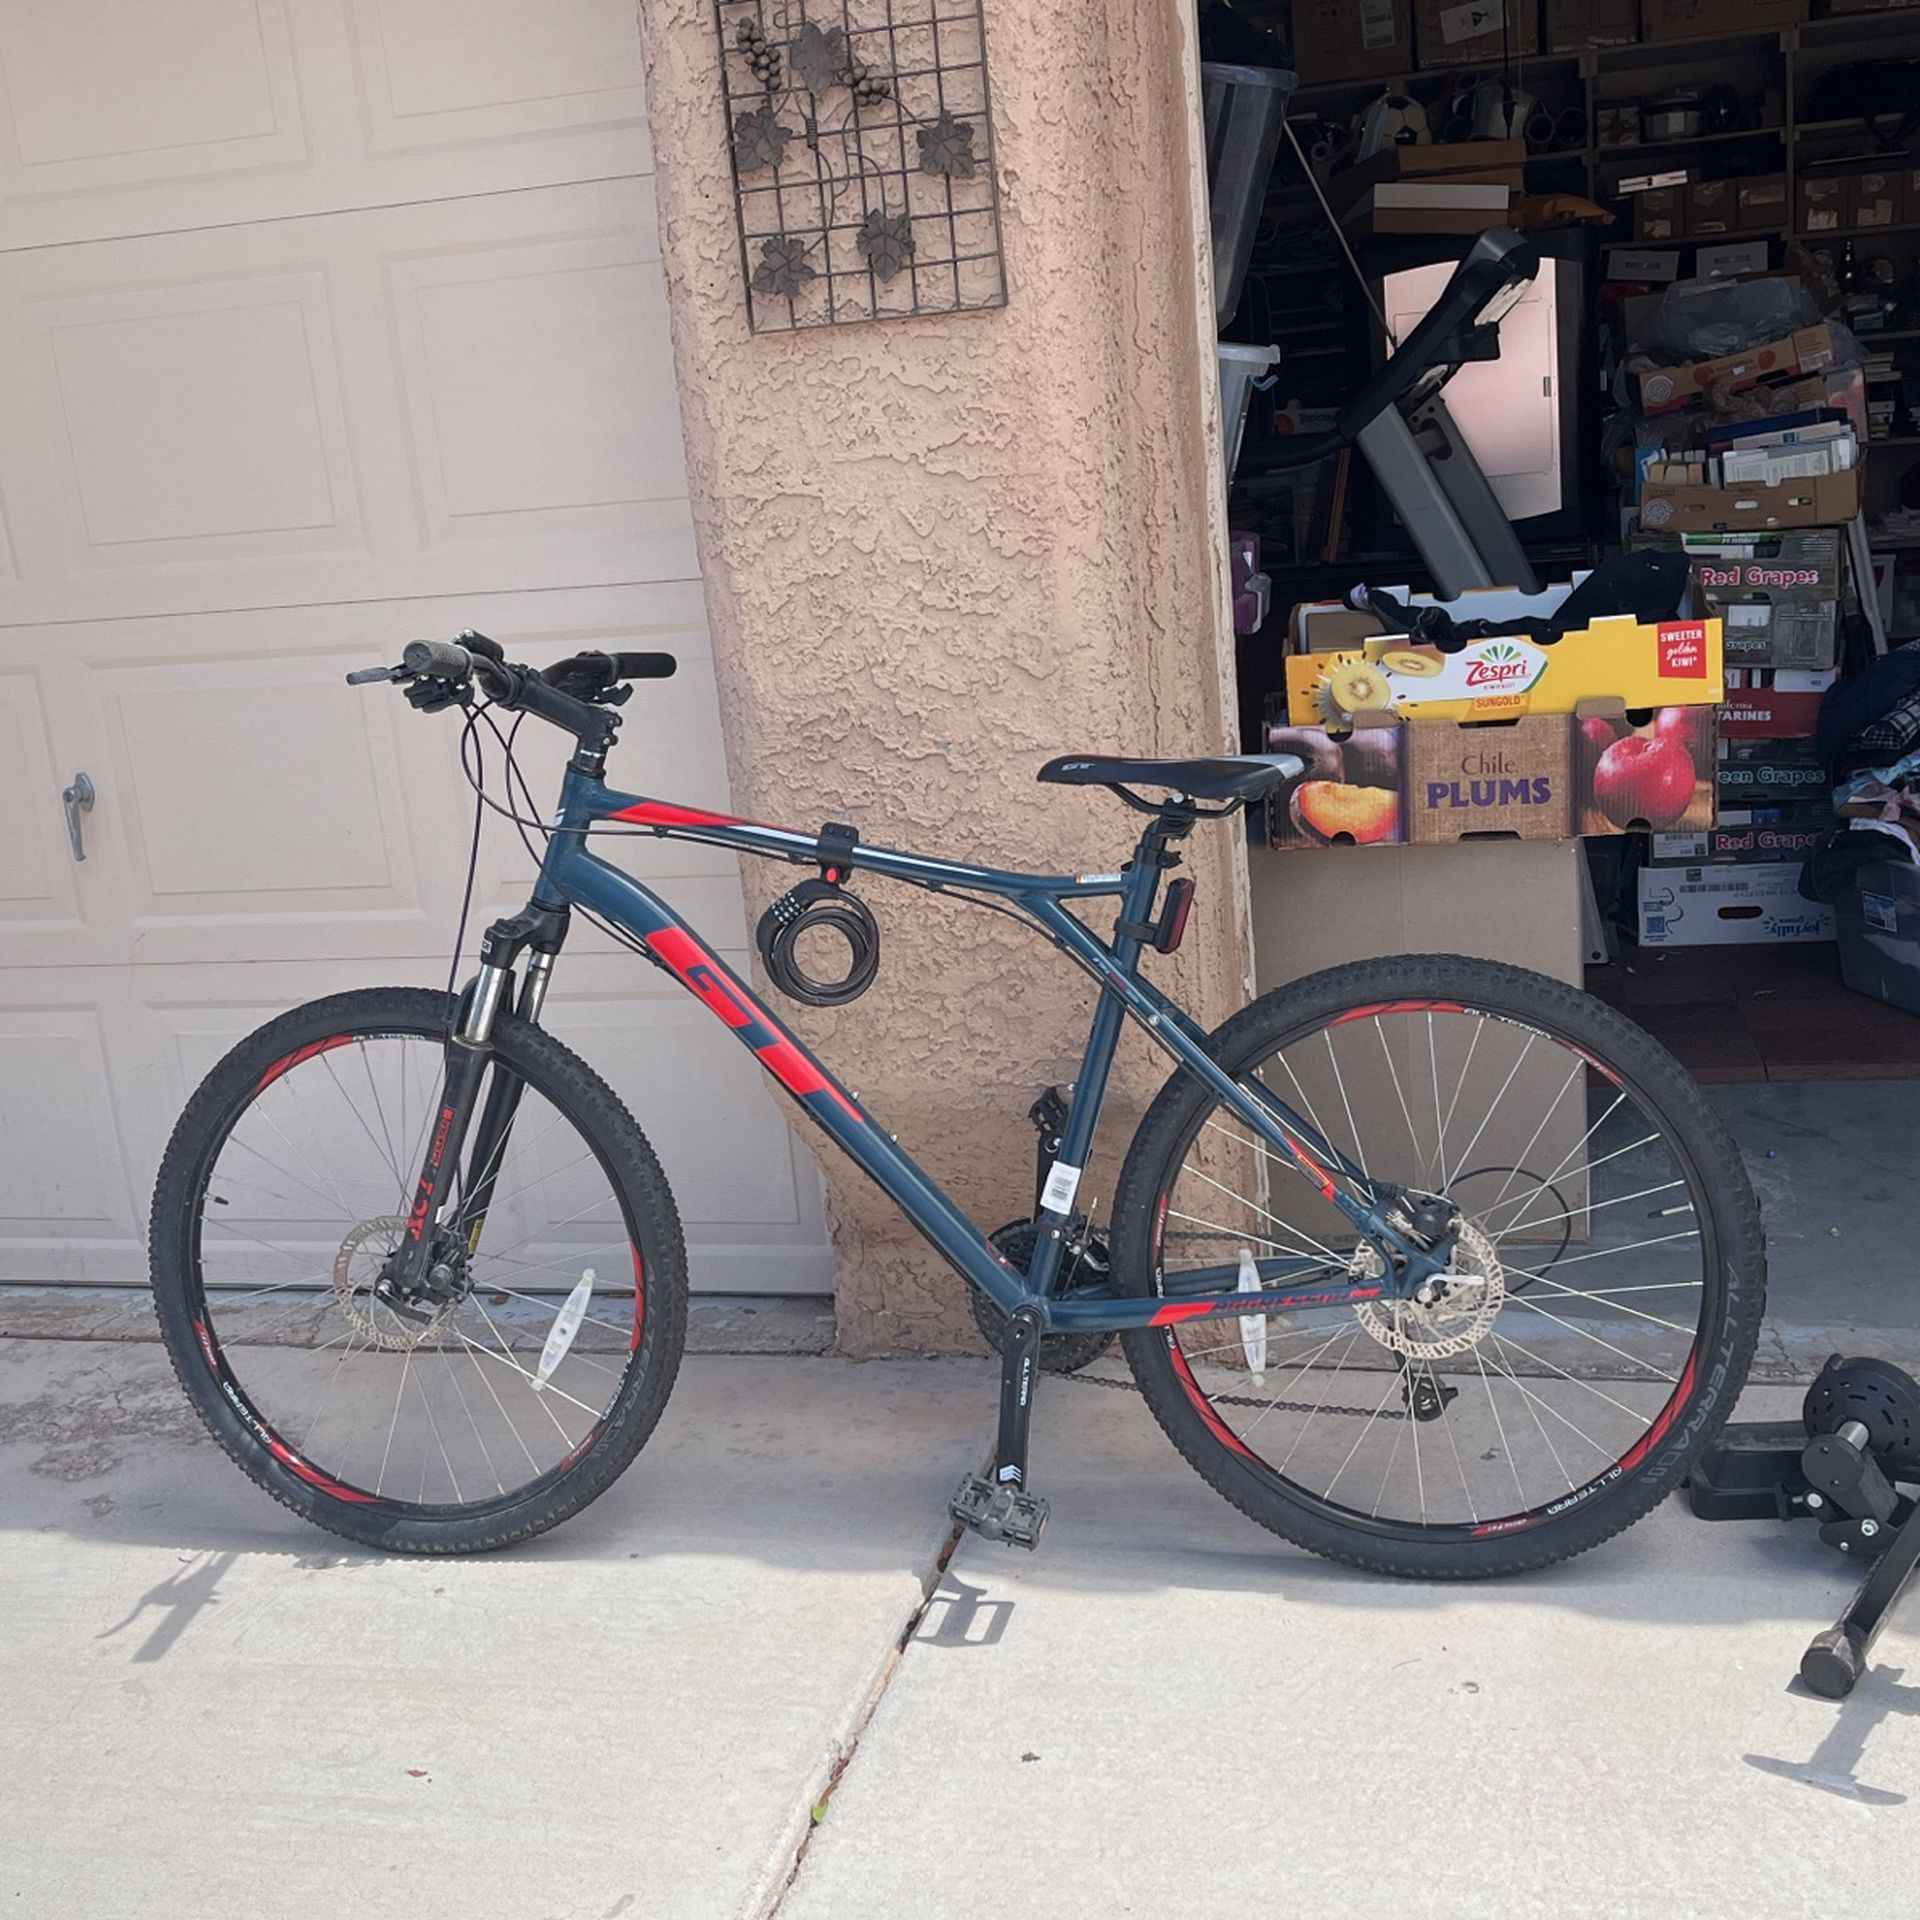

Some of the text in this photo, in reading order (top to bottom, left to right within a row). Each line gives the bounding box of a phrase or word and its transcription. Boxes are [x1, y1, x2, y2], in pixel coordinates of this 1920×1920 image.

[1700, 566, 1819, 589] Red Grapes
[1660, 629, 1703, 642] SWEETER
[1666, 641, 1698, 660] golden
[1465, 660, 1527, 687] Zespri
[1476, 695, 1521, 709] SUNGOLD
[1716, 710, 1772, 721] TARINES
[1461, 752, 1517, 776] Chile
[1717, 766, 1826, 788] een Grapes
[1427, 777, 1552, 809] PLUMS
[1715, 832, 1754, 850] Red
[1759, 831, 1818, 851] Grape
